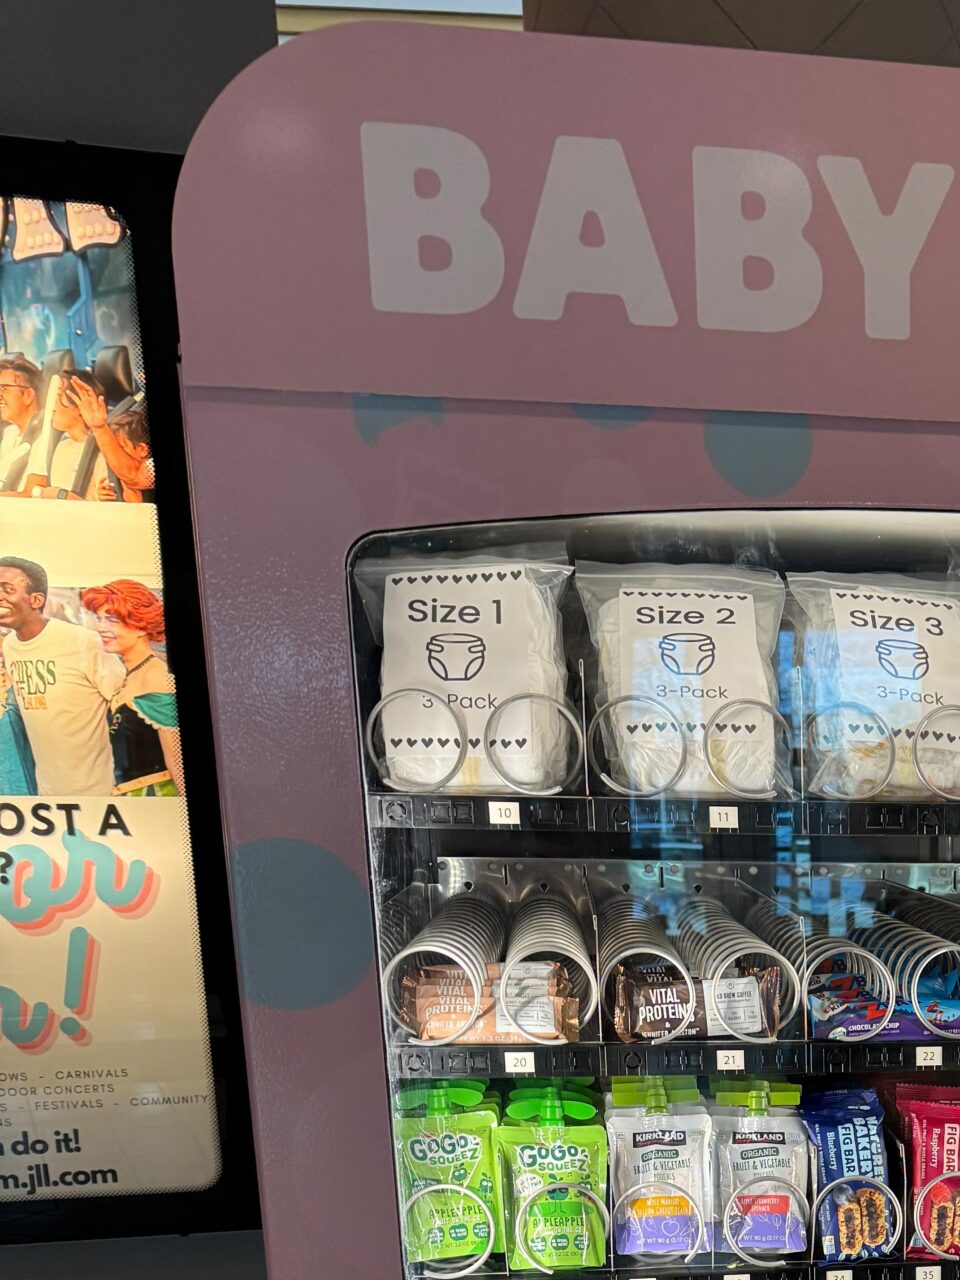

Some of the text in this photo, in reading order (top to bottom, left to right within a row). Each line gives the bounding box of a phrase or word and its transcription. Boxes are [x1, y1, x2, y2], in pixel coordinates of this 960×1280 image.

[360, 121, 955, 340] BABY
[408, 598, 503, 625] Size 1
[636, 606, 737, 625] Size 2
[849, 609, 944, 637] Size 3
[656, 684, 729, 700] 3-Pack
[876, 685, 944, 706] 3-Pack
[98, 803, 133, 837] A
[497, 807, 512, 819] 10
[716, 811, 729, 823] 11
[648, 987, 681, 1004] VITAL
[885, 1022, 900, 1030] CHIP
[513, 1058, 527, 1068] 20
[724, 1055, 736, 1065] 21
[922, 1051, 935, 1061] 22
[55, 1068, 129, 1080] CARNIVALS
[43, 1083, 115, 1095] CONCERTS
[35, 1094, 210, 1111] FESTIVALS COMMUNITY
[11, 1131, 49, 1156] do
[54, 1128, 82, 1153] it!
[635, 1131, 685, 1143] KIRKLAND
[735, 1133, 783, 1142] KIRKLAND
[642, 1149, 677, 1161] ORGANIC
[742, 1147, 778, 1159] ORGANIC
[826, 1131, 838, 1171] Blueberry
[840, 1126, 857, 1174] FIG BAR
[852, 1117, 874, 1178] BAKERY
[929, 1127, 941, 1169] Raspberry
[945, 1126, 958, 1172] FIG BAR
[633, 1157, 691, 1176] FRUIT & VEGETABLE
[732, 1157, 791, 1173] FRUIT & VEGETABLE
[922, 1270, 934, 1280] 35
